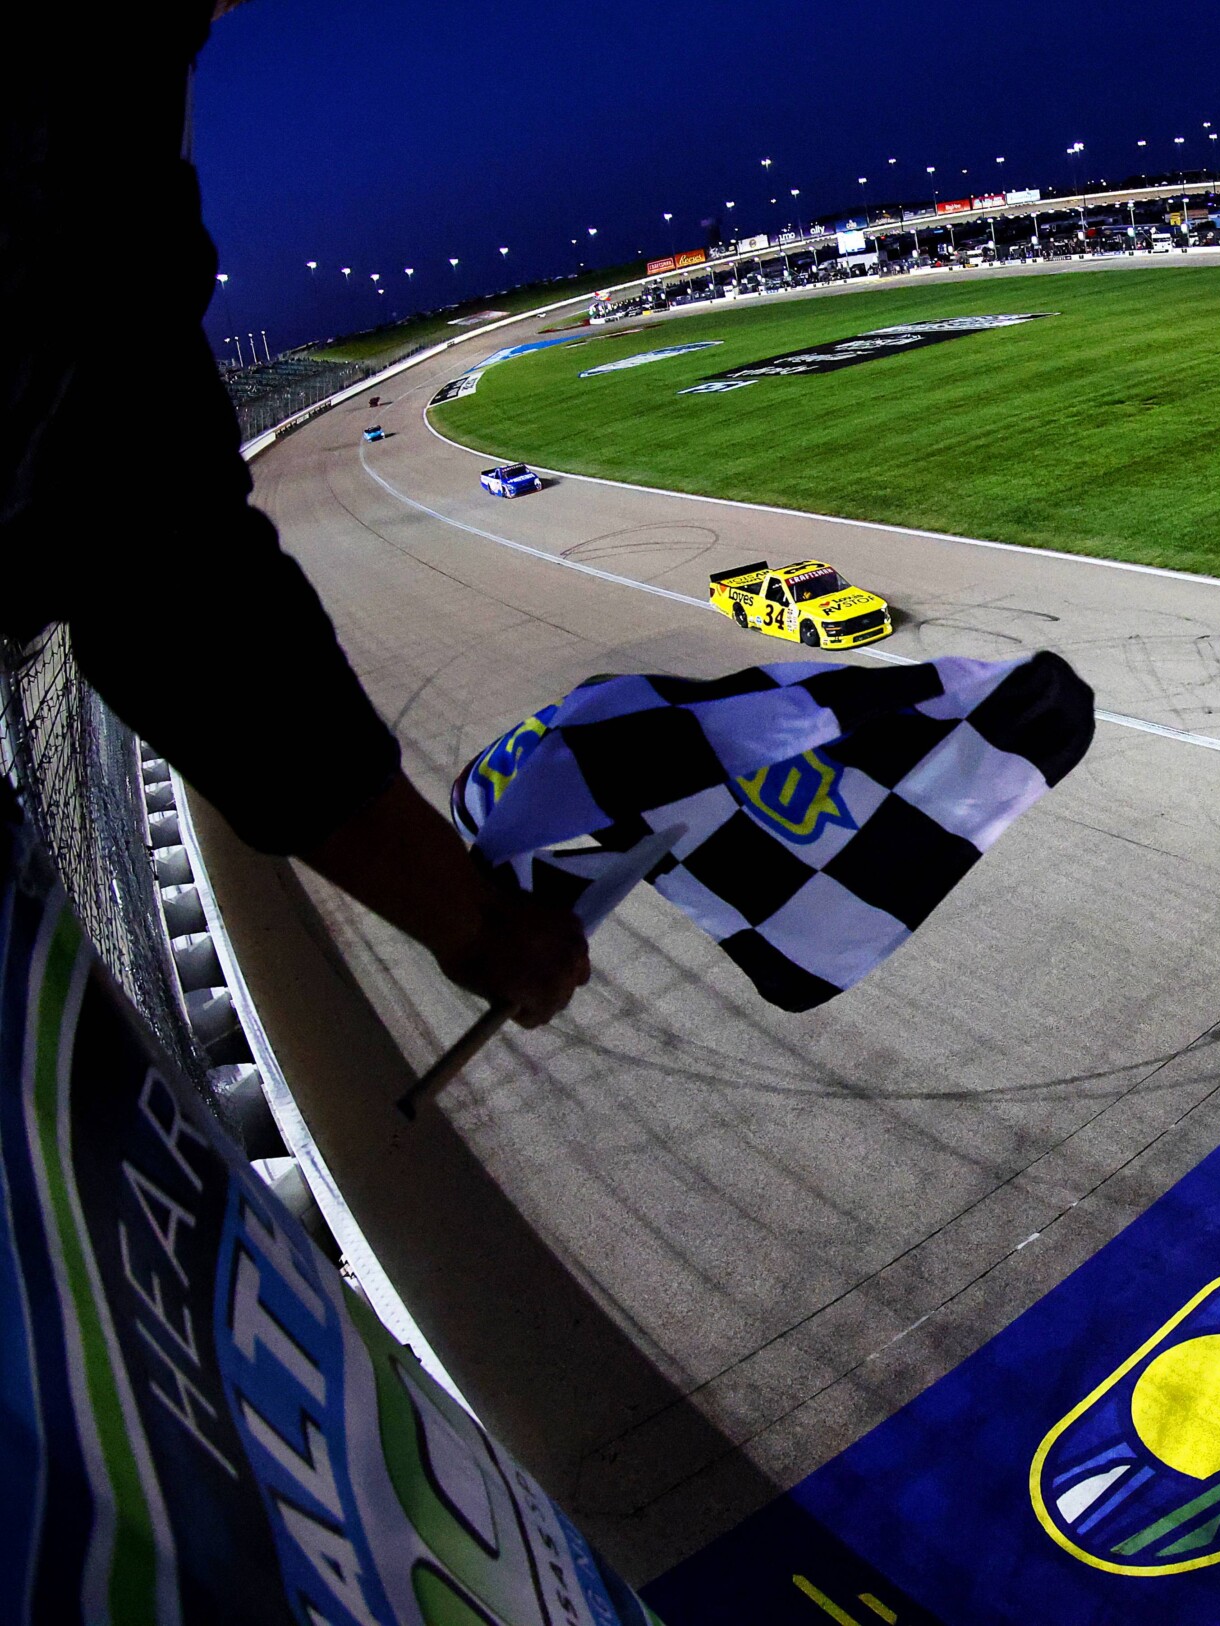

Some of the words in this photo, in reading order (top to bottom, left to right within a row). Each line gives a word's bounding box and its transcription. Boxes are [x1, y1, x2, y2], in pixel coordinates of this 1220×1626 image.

[810, 225, 825, 236] ally
[788, 567, 834, 585] CRAFTSMAN
[764, 603, 785, 631] 34
[822, 603, 842, 616] RV
